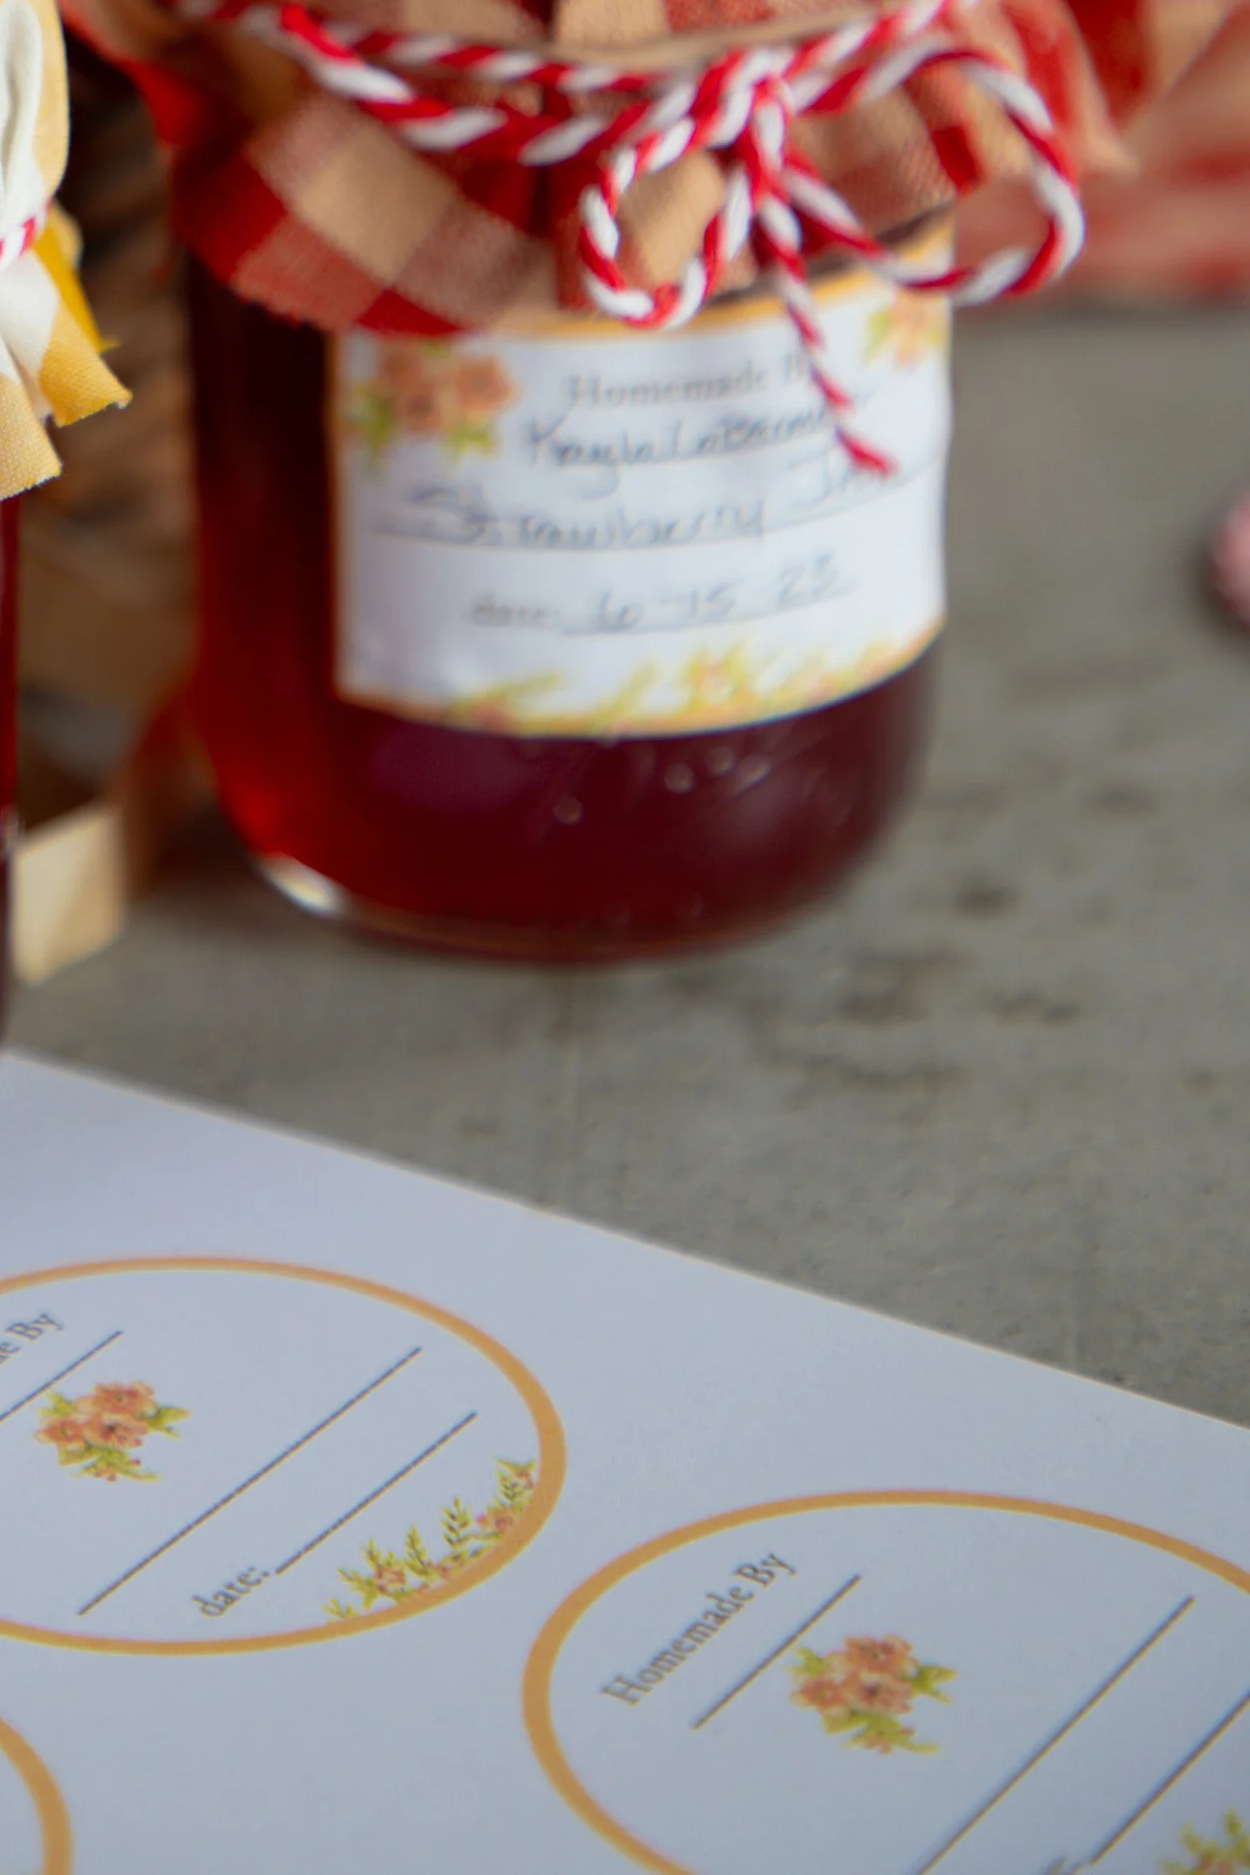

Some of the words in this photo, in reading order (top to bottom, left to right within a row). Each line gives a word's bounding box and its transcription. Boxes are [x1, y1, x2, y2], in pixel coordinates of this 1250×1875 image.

[4, 1312, 64, 1342] By
[191, 1565, 271, 1618] date:
[601, 1586, 755, 1706] Homemade
[734, 1553, 797, 1589] By
